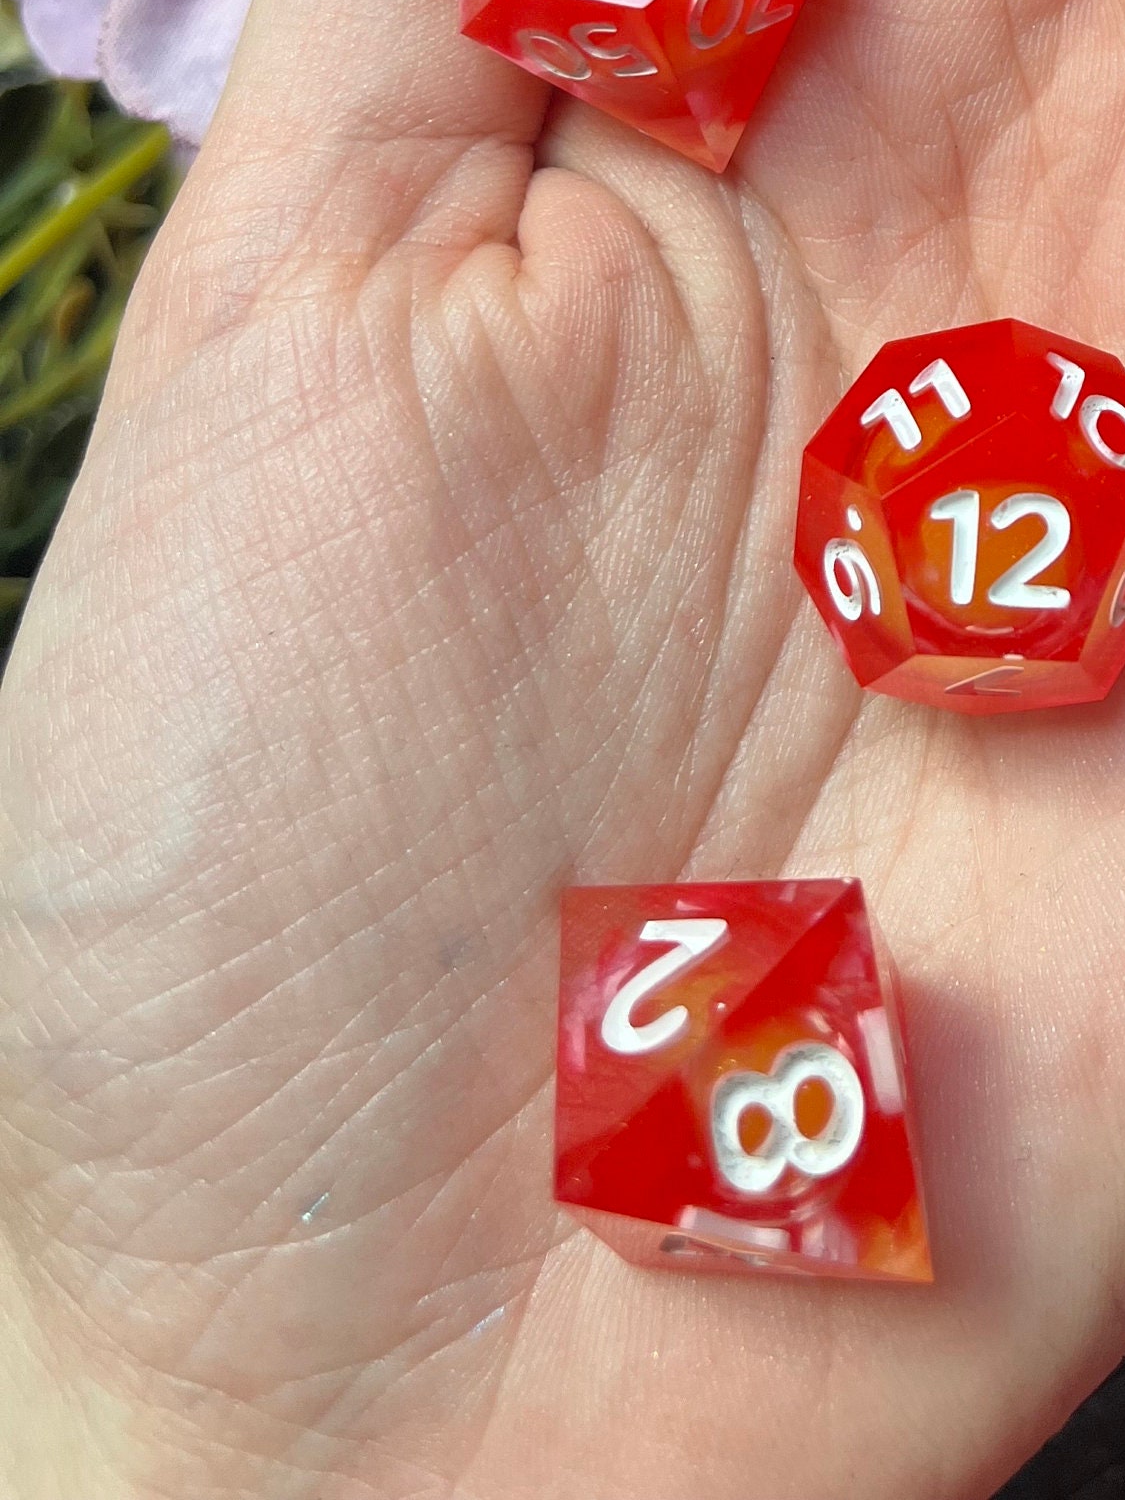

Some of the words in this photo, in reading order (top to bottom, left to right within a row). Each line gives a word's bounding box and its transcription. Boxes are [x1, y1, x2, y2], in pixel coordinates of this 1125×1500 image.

[516, 22, 658, 81] 50
[860, 358, 971, 451] 11
[930, 489, 1071, 609] 12
[601, 917, 729, 1054] 2
[711, 1041, 865, 1192] 8
